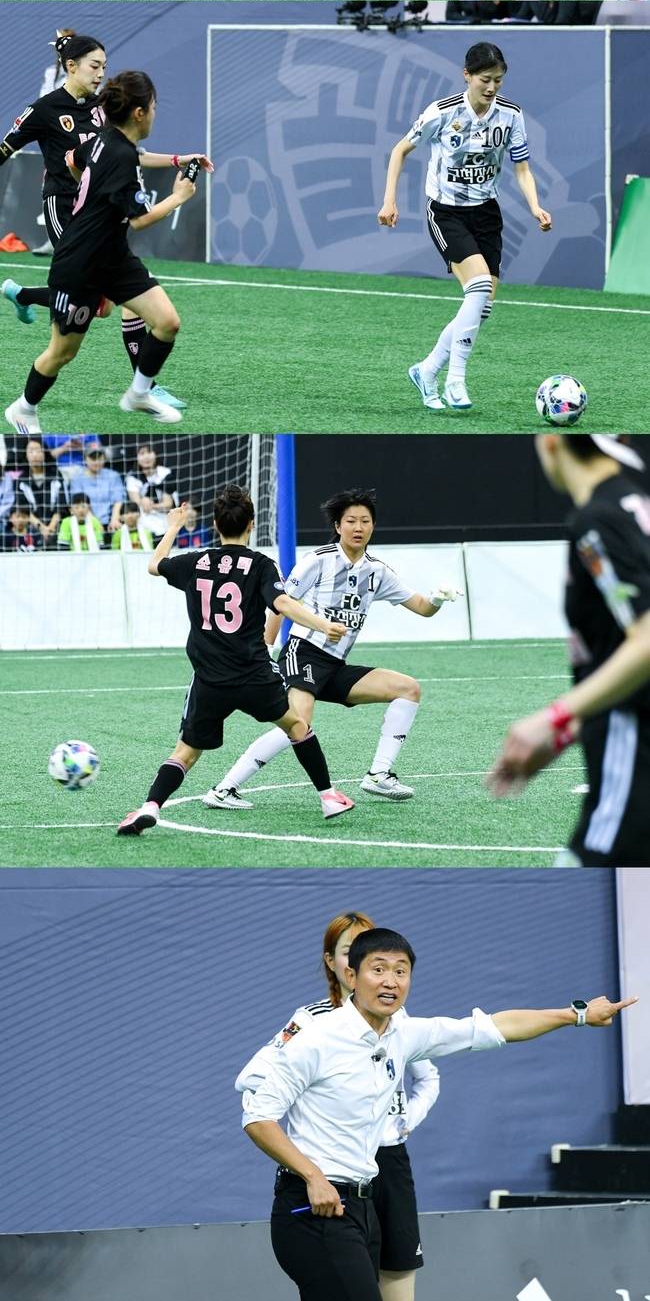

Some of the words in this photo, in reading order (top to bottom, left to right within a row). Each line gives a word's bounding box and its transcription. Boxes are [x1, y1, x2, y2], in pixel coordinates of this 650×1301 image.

[462, 152, 487, 165] FC
[66, 303, 90, 326] 10
[367, 571, 376, 593] 1
[196, 578, 243, 634] 13
[340, 593, 361, 610] FC
[302, 663, 316, 685] 1
